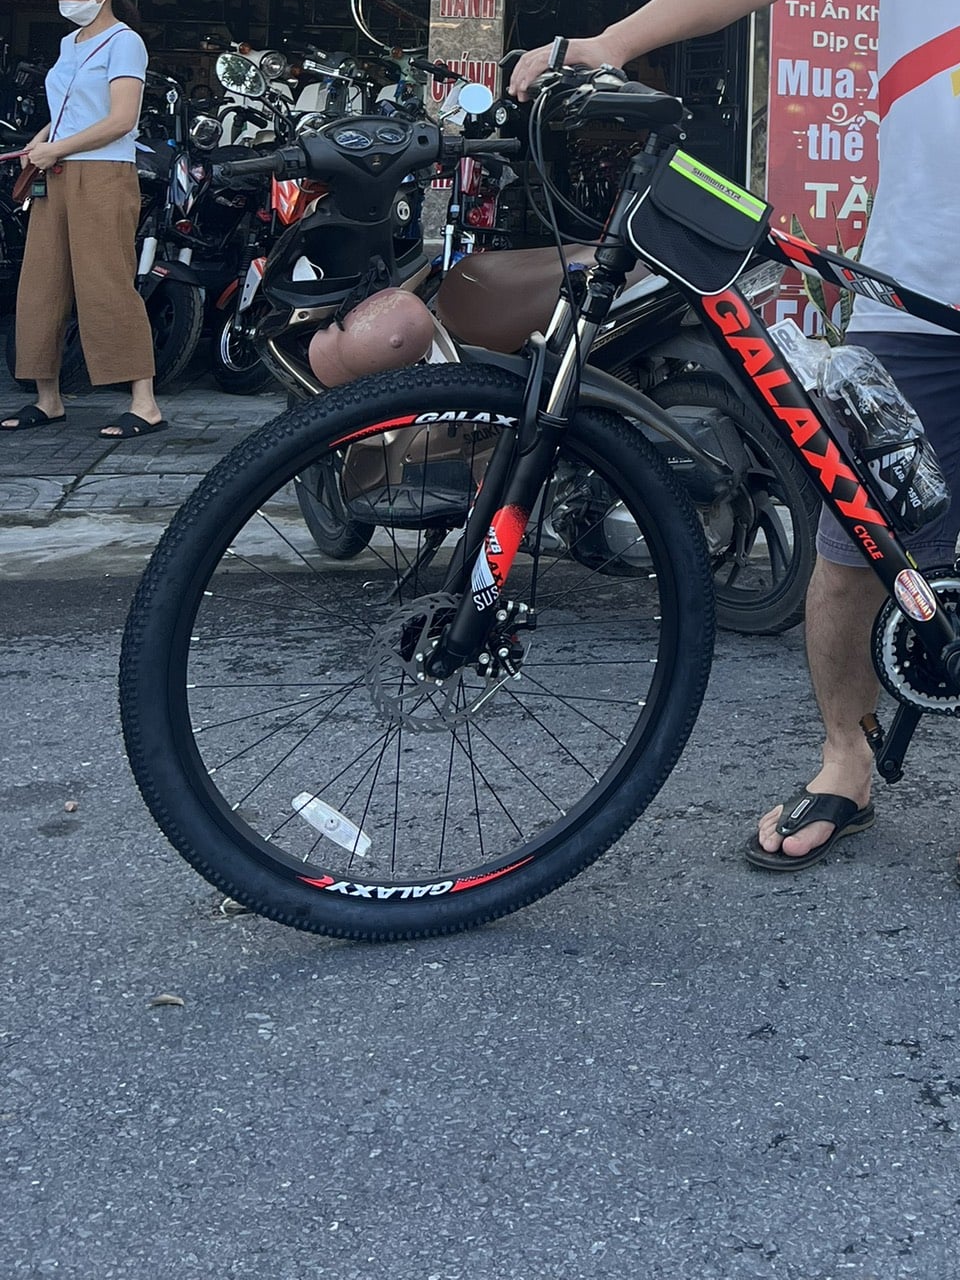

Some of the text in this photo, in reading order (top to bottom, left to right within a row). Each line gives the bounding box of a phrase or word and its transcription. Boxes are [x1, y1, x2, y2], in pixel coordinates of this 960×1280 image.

[785, 0, 816, 18] Tri
[812, 31, 849, 52] Dịp
[777, 58, 856, 99] Mua
[806, 115, 867, 162] thể
[414, 410, 519, 428] GALAX
[701, 289, 888, 527] GALAXY
[853, 524, 884, 561] CYCLE
[325, 880, 454, 900] GALAXY
